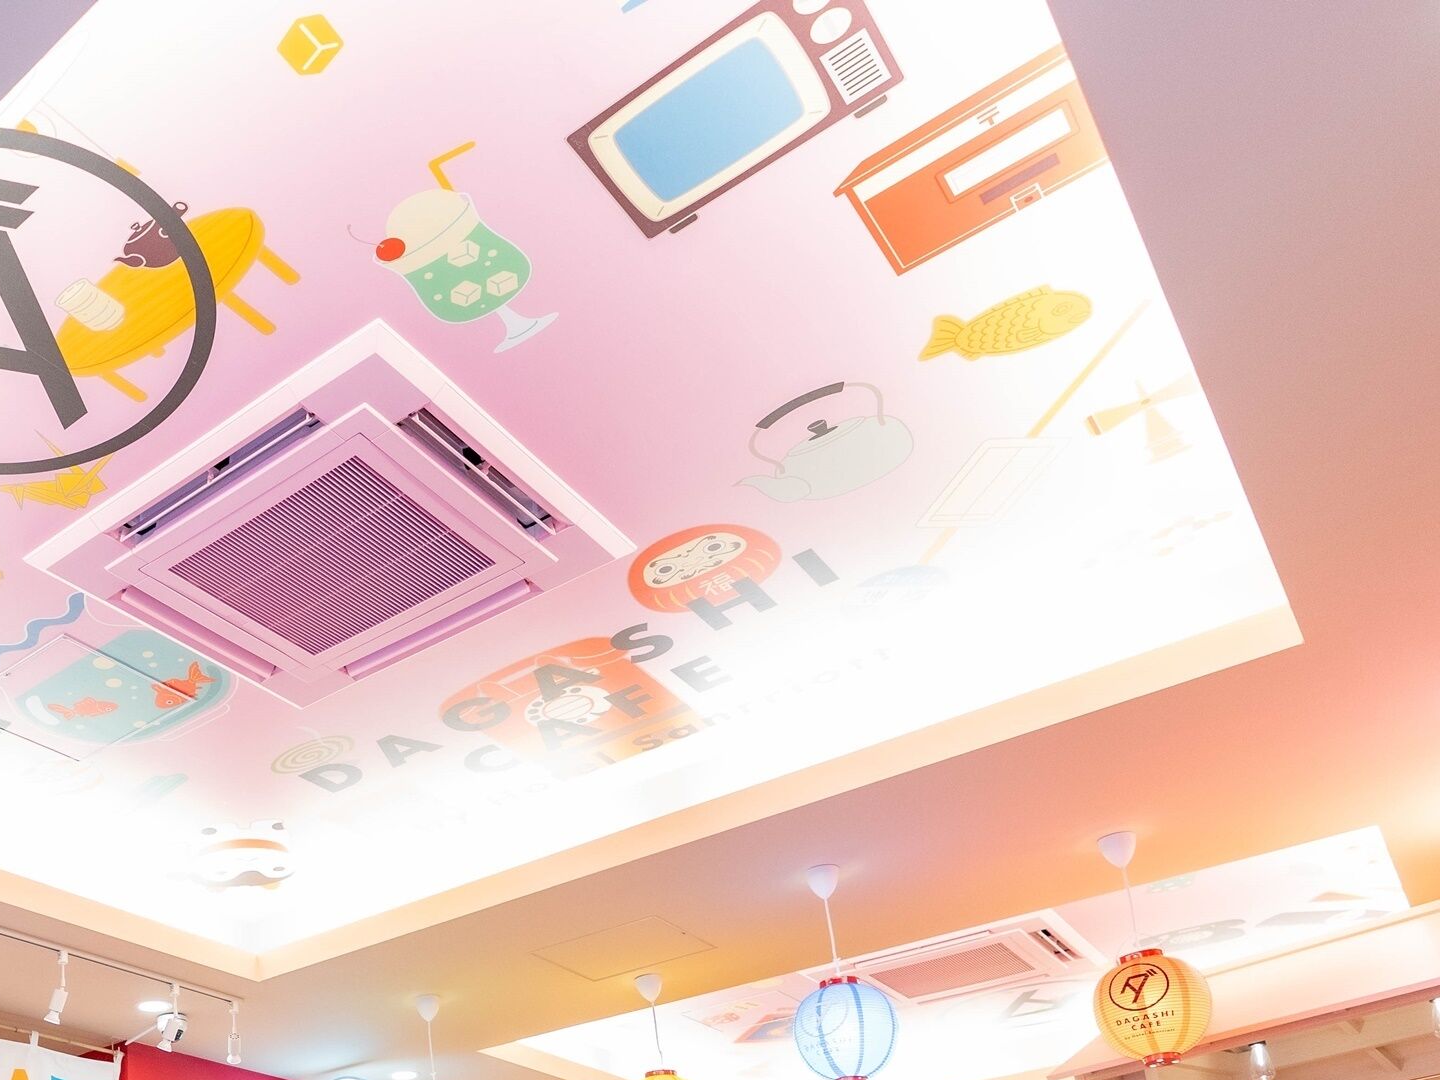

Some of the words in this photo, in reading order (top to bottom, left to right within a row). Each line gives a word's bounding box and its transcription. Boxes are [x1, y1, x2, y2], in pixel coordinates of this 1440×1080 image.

[299, 548, 840, 793] DAGASHI
[464, 655, 733, 775] CAFE
[1116, 1010, 1175, 1026] DAGASHI
[1131, 1021, 1162, 1031] CAFE
